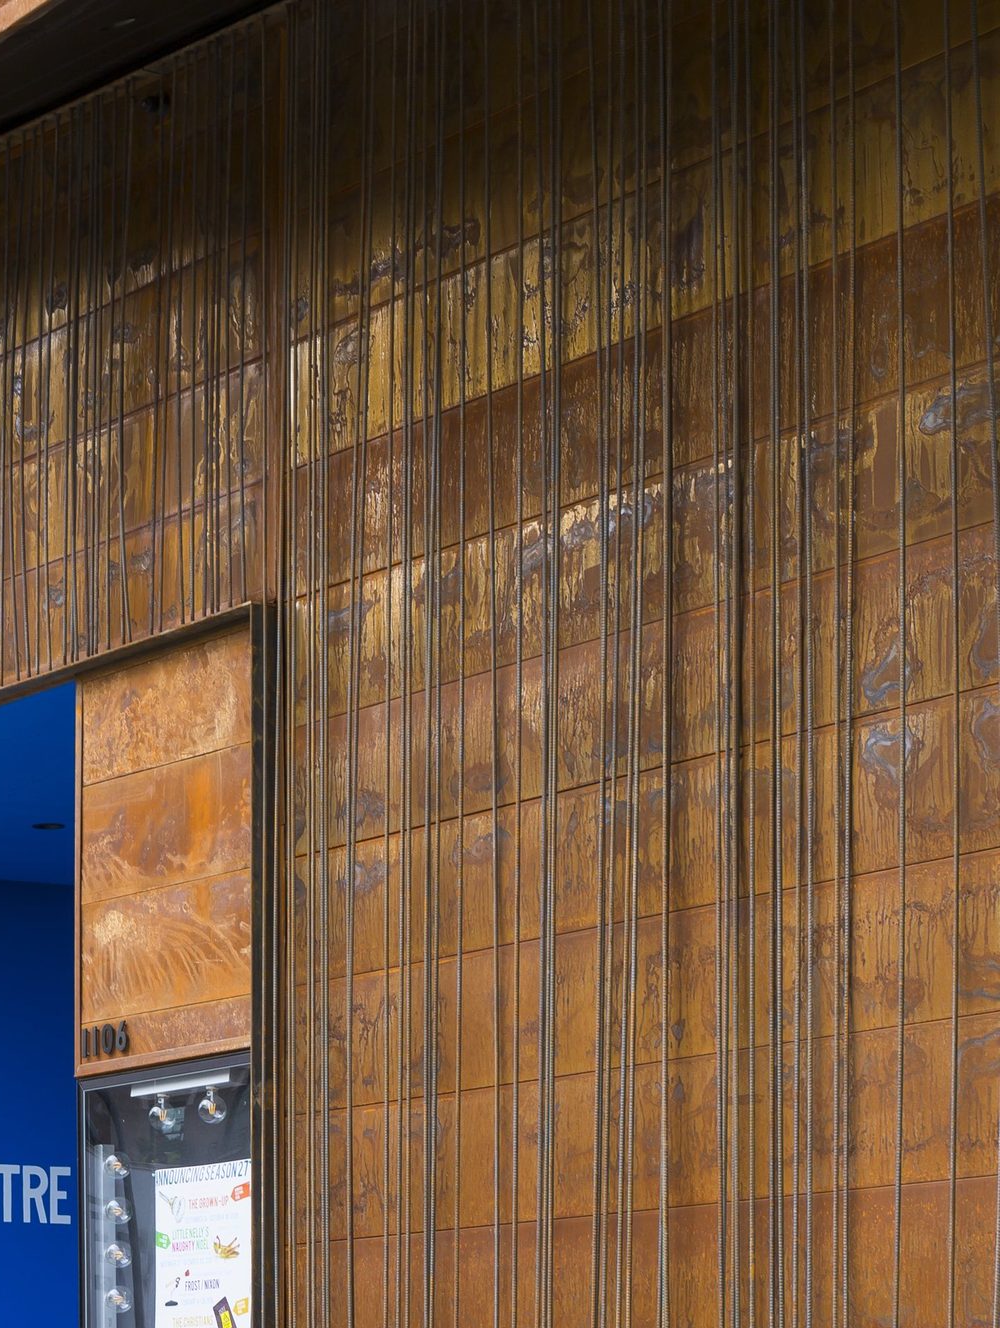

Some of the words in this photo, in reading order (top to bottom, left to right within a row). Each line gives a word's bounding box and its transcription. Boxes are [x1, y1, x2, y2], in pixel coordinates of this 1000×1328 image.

[82, 1019, 127, 1058] 1106
[205, 1163, 237, 1181] SEASON
[238, 1160, 249, 1177] 27
[189, 1199, 198, 1209] THE
